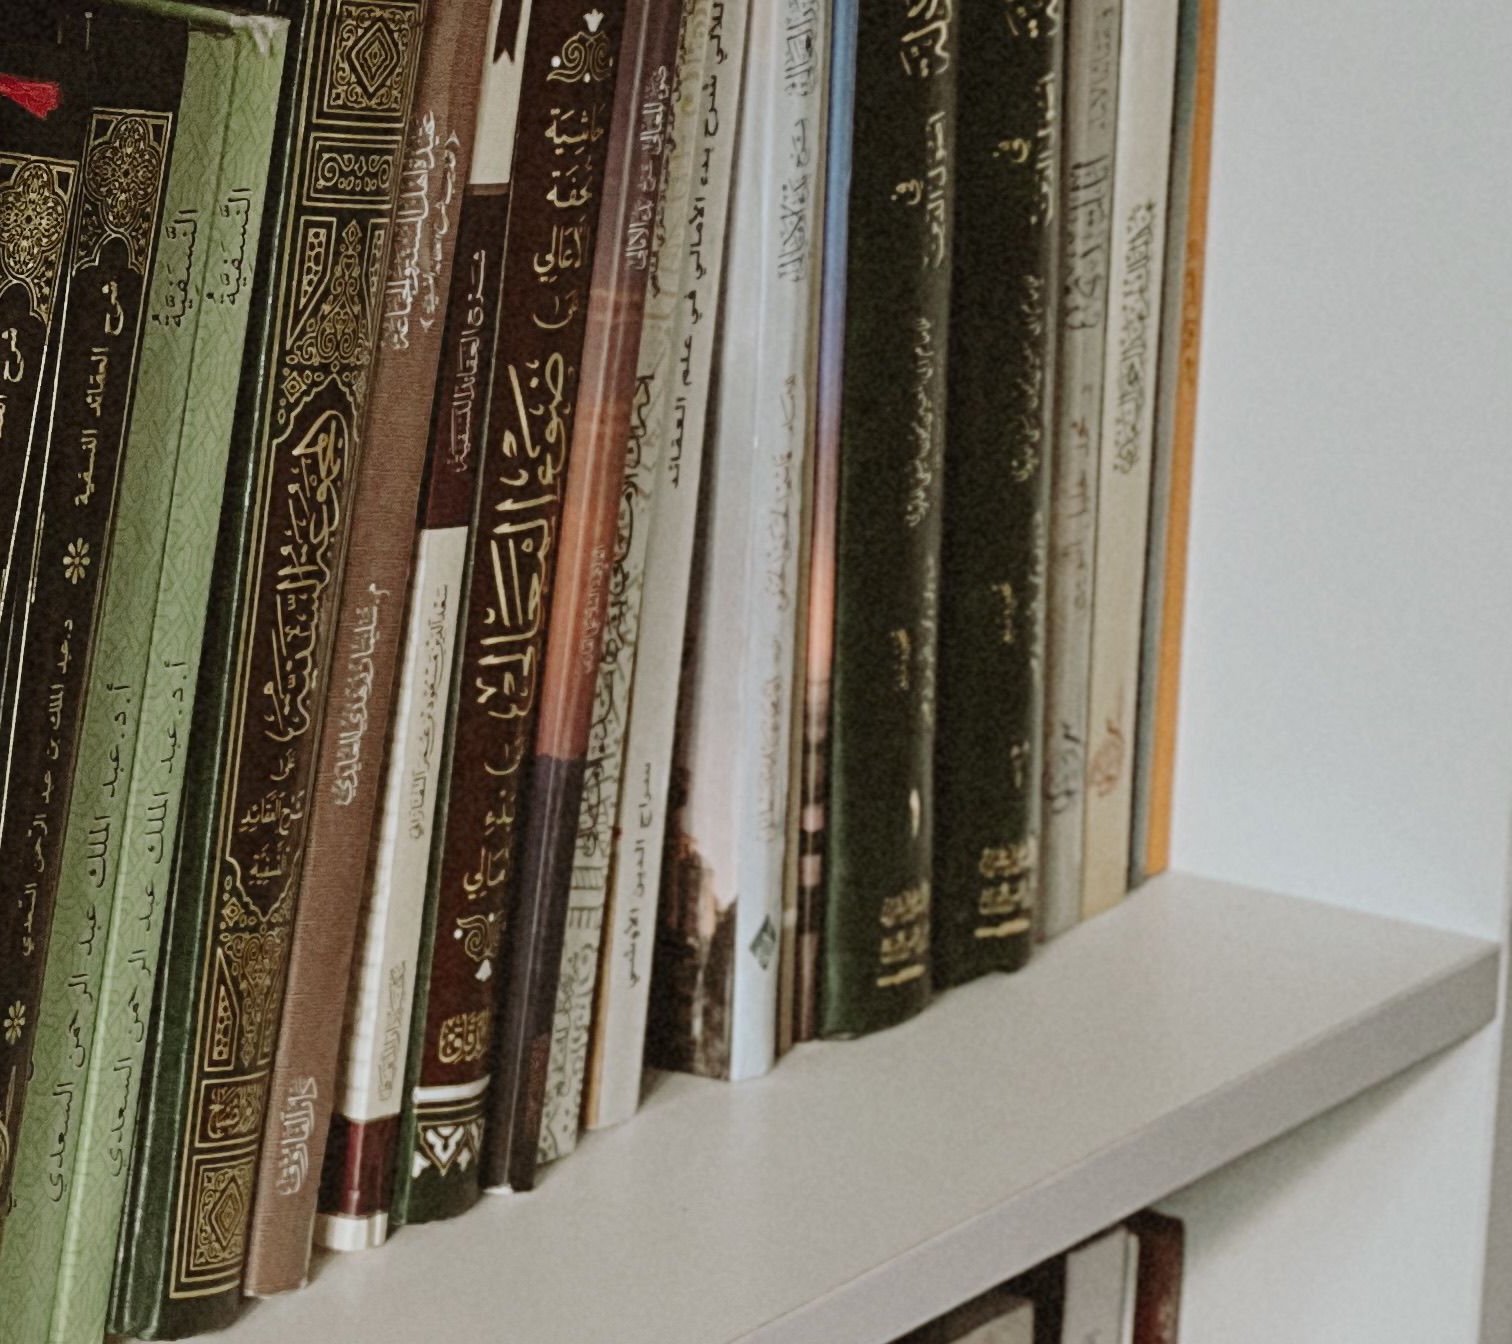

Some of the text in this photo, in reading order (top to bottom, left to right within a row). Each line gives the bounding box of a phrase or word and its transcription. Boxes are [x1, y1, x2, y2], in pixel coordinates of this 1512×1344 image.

[701, 73, 720, 138] شرح
[699, 147, 713, 186] بدء
[687, 196, 707, 280] الأمالي
[682, 289, 703, 326] في
[0, 326, 26, 383] شرح
[449, 248, 487, 473] شرح العقائد النسفية
[679, 334, 694, 385] علم
[73, 280, 126, 505] شرح العقائد النسفية
[667, 396, 687, 488] العقائد
[101, 744, 121, 795] عبد
[159, 722, 182, 774] عبد
[16, 683, 66, 957] الملك بن عبد الرحمن السعدي
[144, 791, 170, 865] الملك
[637, 761, 654, 830] سراج
[85, 814, 112, 887] الملك
[625, 839, 651, 898] الدين
[78, 904, 98, 949] عبد
[138, 883, 157, 929] عبد
[48, 1079, 75, 1202] السعدي
[108, 1055, 134, 1176] السعدي
